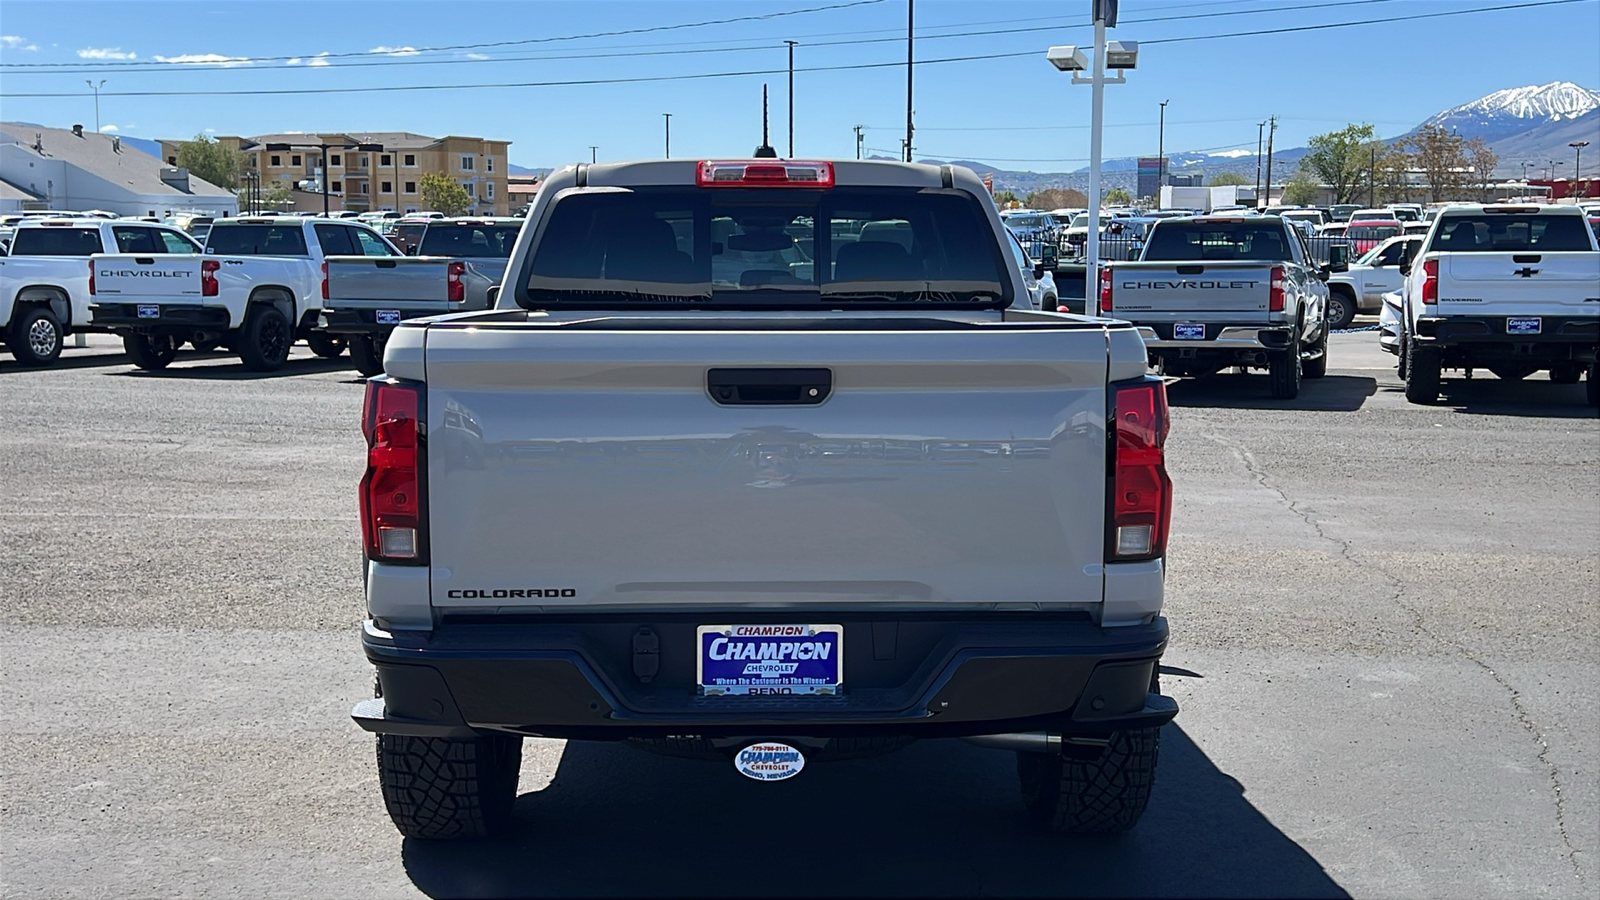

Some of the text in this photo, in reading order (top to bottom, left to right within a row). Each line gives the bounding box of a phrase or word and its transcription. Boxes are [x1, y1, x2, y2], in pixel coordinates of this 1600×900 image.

[1123, 281, 1259, 289] CHEVROLET
[447, 588, 576, 599] COLORADO
[736, 626, 804, 635] CHAMPION
[709, 638, 831, 660] CHAMPION
[740, 750, 799, 763] CHAMPION
[767, 768, 797, 779] NEVADA
